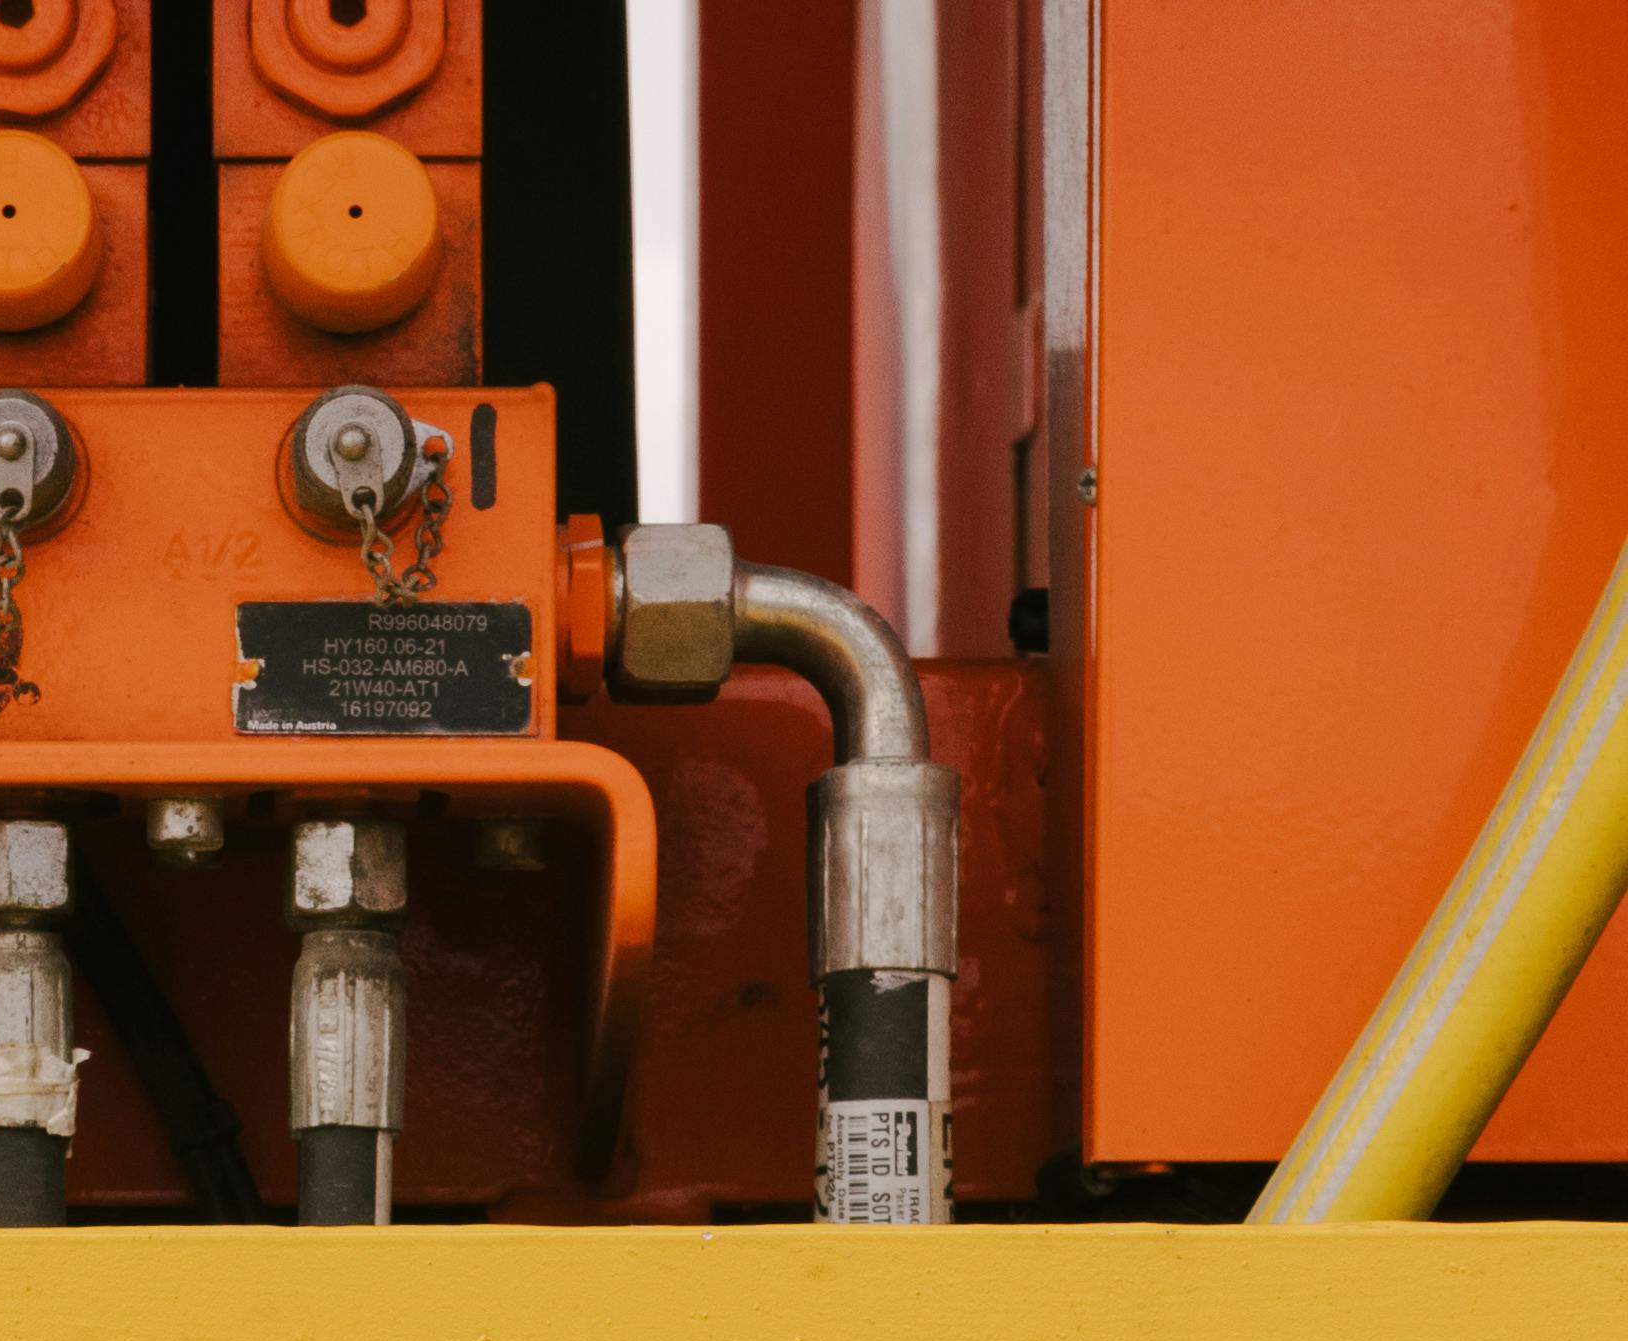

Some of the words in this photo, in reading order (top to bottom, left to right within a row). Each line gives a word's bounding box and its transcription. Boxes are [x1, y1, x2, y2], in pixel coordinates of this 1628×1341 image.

[368, 614, 488, 632] R996048079
[324, 638, 446, 655] HY160.06-21
[303, 659, 469, 676] HS-032-AM680-A
[329, 680, 439, 697] 21W40-AT1
[340, 701, 432, 718] 16197092
[247, 720, 279, 731] Made
[281, 720, 293, 731] in
[296, 720, 337, 731] Austria
[871, 1112, 890, 1148] PTS
[836, 1113, 845, 1181] Assembly
[871, 1158, 890, 1177] ID
[837, 1188, 846, 1219] Date
